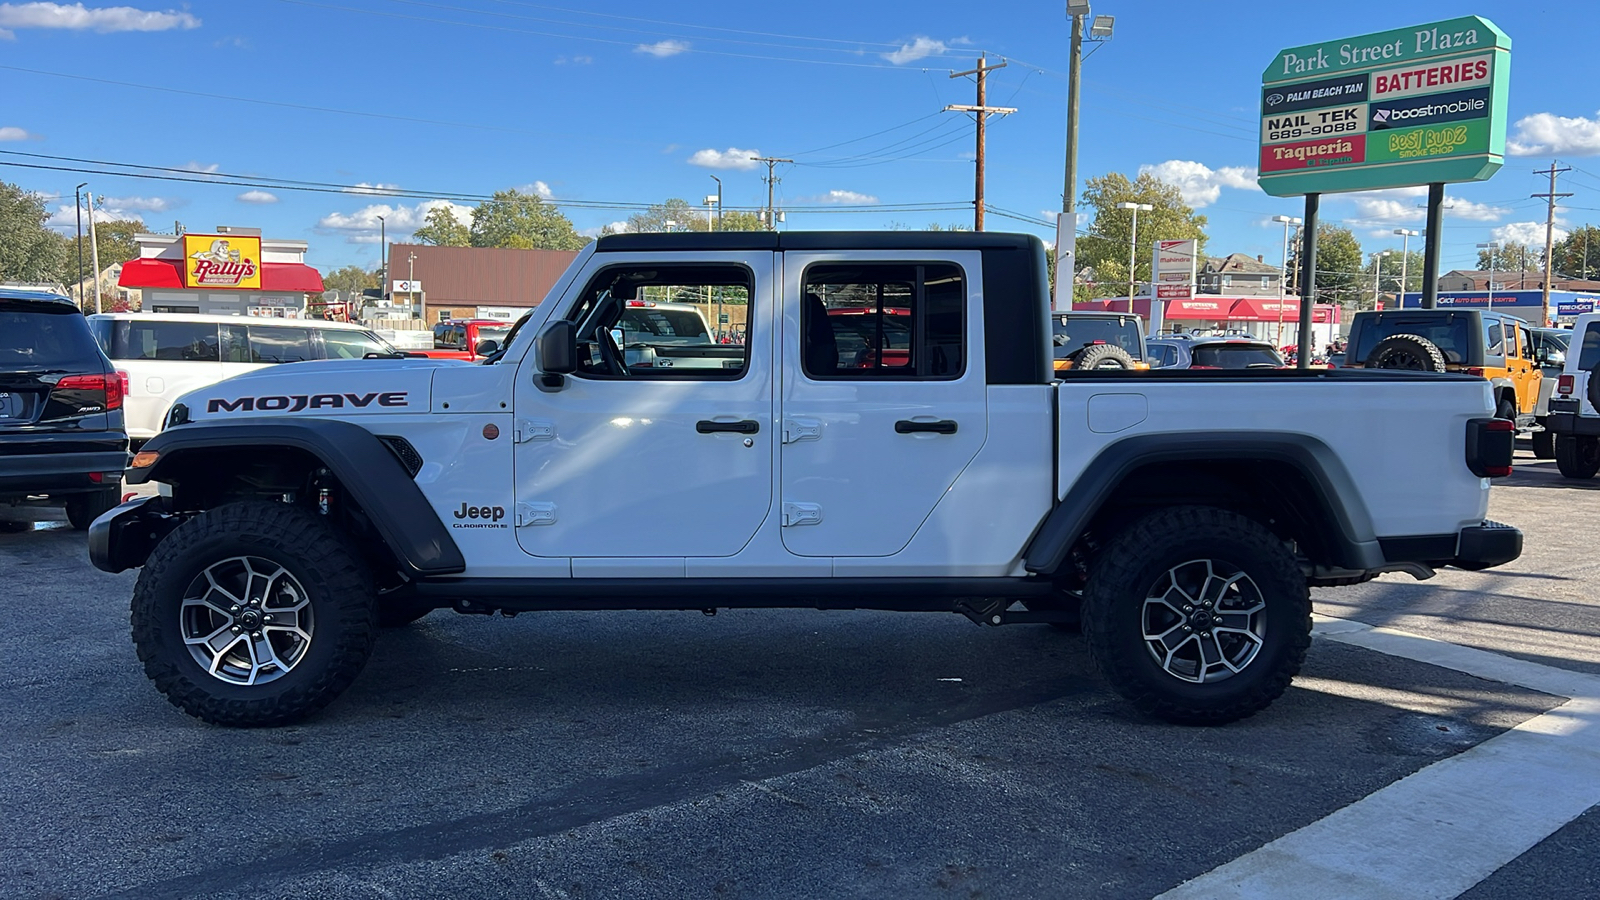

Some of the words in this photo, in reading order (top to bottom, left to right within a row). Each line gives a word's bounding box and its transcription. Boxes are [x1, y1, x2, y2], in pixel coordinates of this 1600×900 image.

[1283, 48, 1330, 75] Park
[1340, 38, 1403, 66] Street
[1415, 28, 1478, 53] Plaza
[1376, 60, 1488, 94] BATTERIES
[1286, 91, 1311, 103] PALM
[1312, 86, 1343, 98] BEACH
[1345, 83, 1364, 94] TAN
[1268, 115, 1310, 130] NAIL
[1318, 107, 1359, 124] TEK
[1391, 98, 1485, 120] boostmobile
[1270, 121, 1357, 140] 689-9088
[1425, 125, 1468, 148] BUDZ
[1307, 158, 1316, 166] El
[1399, 148, 1429, 159] SMOKE
[1429, 145, 1454, 157] SHOP
[193, 258, 255, 283] Rally's
[207, 392, 409, 413] MOJAVE
[453, 502, 505, 522] Jeep
